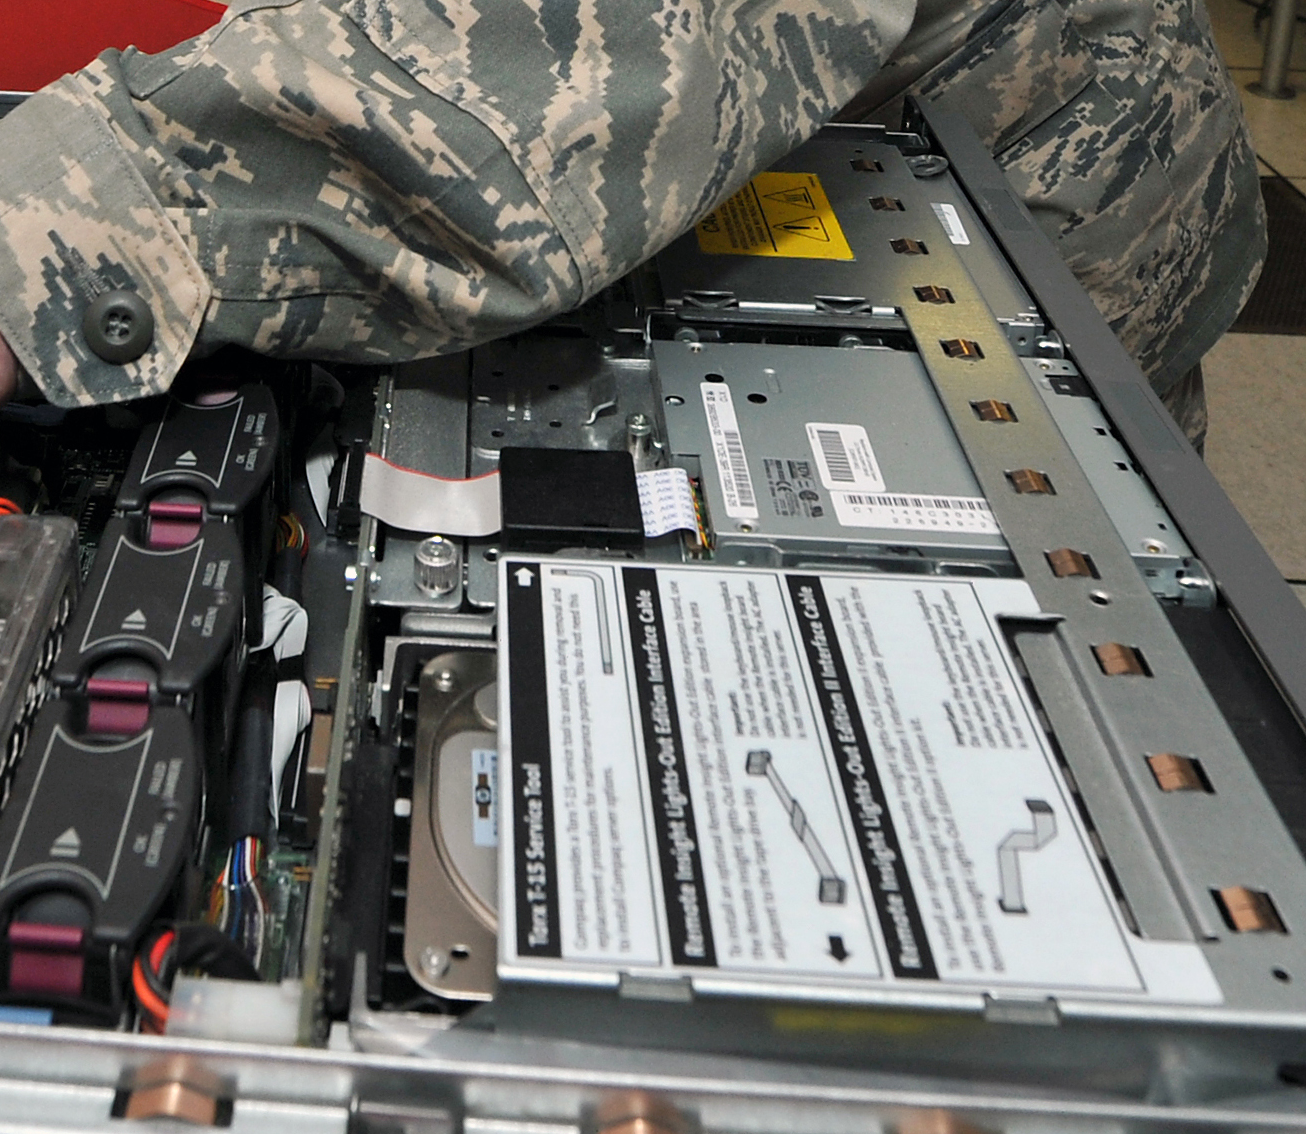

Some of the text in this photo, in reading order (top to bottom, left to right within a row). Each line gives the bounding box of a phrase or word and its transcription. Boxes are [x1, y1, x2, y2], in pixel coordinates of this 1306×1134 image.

[523, 764, 548, 946] Torx T-15 Service Tool
[636, 590, 704, 956] Remote Insight Lights-Out Edition Interface Cable
[799, 586, 920, 967] Remote Insight Lights-Out Edition II Interface Cable
